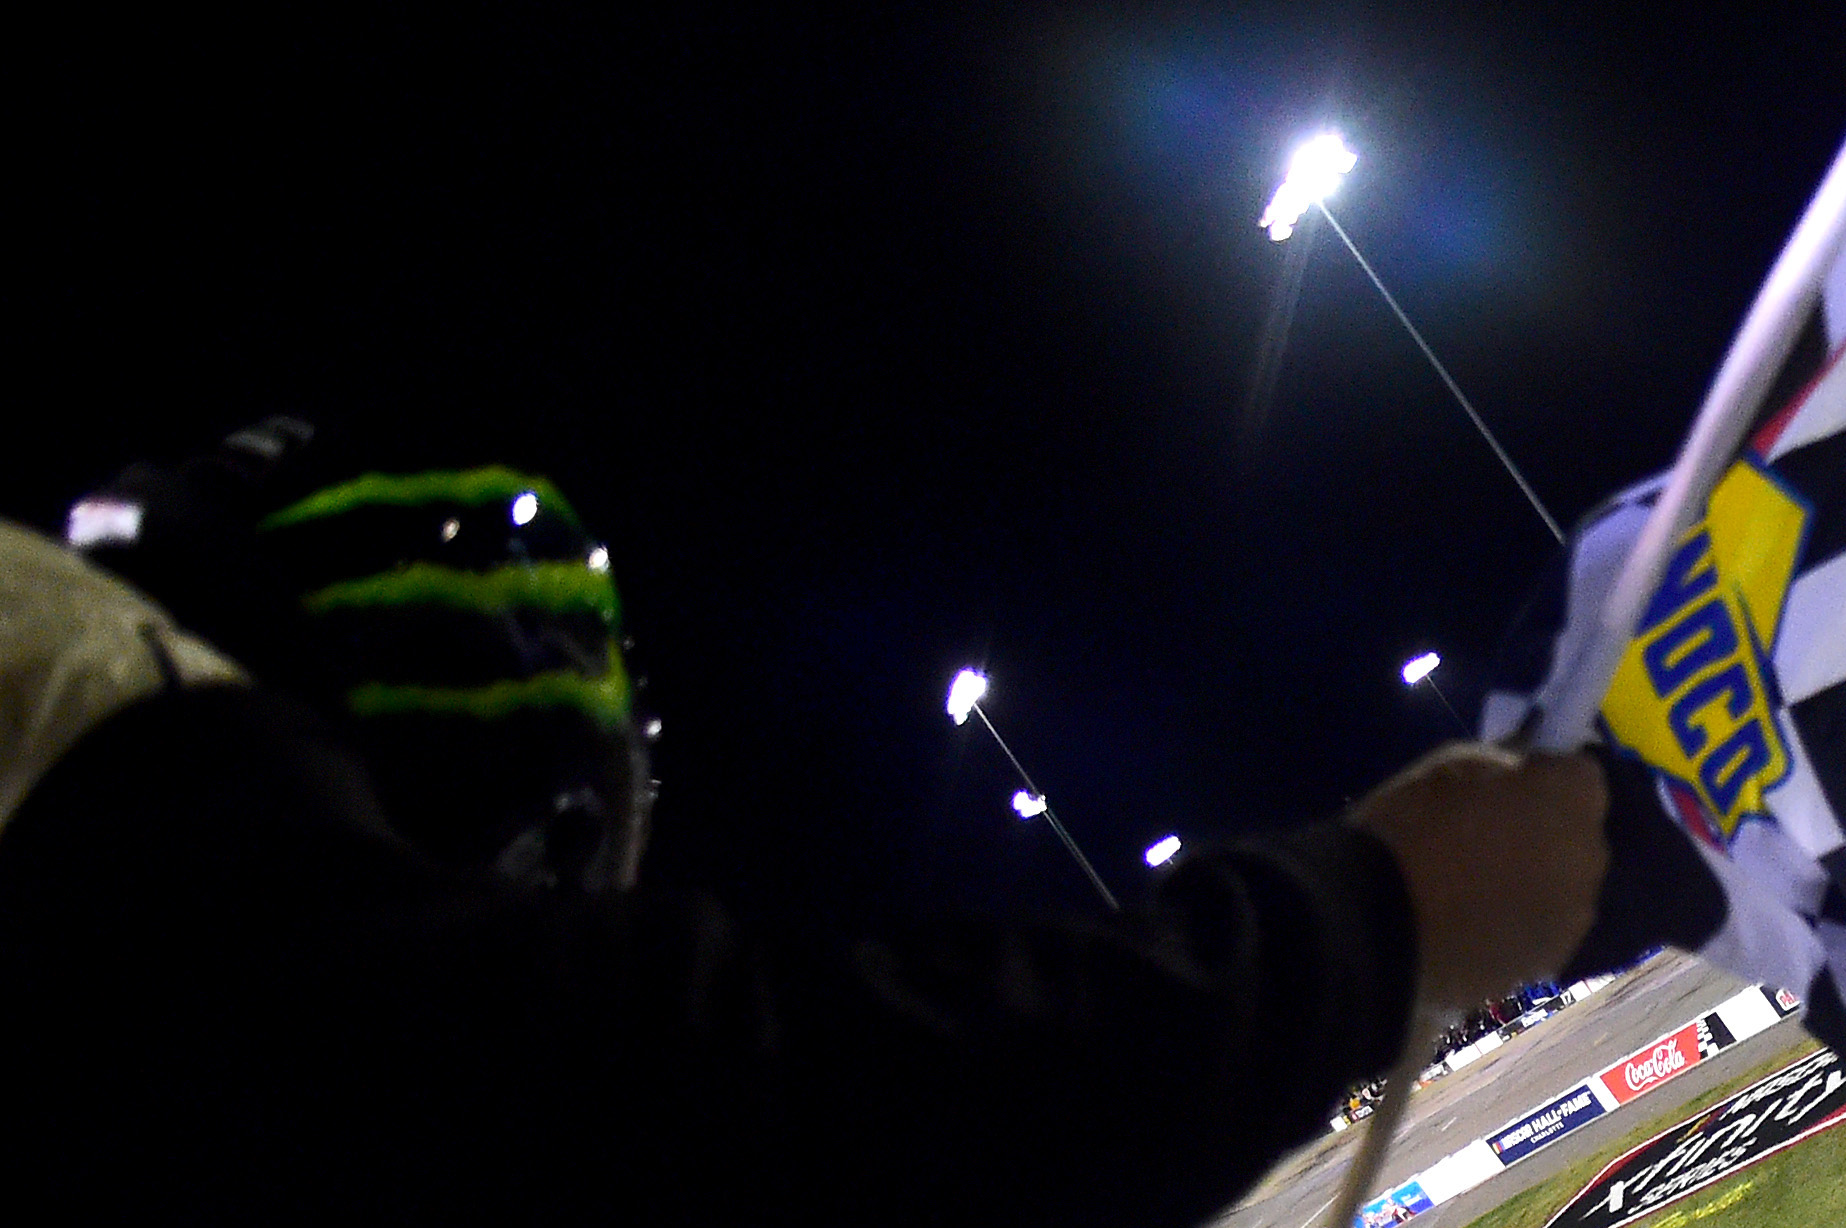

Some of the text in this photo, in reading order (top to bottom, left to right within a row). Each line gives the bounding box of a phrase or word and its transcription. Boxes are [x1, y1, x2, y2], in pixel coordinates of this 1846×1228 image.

[1624, 1039, 1686, 1091] Coca-Cola
[1502, 1120, 1535, 1151] NASCAR
[1530, 1121, 1565, 1144] CHARLOTTE
